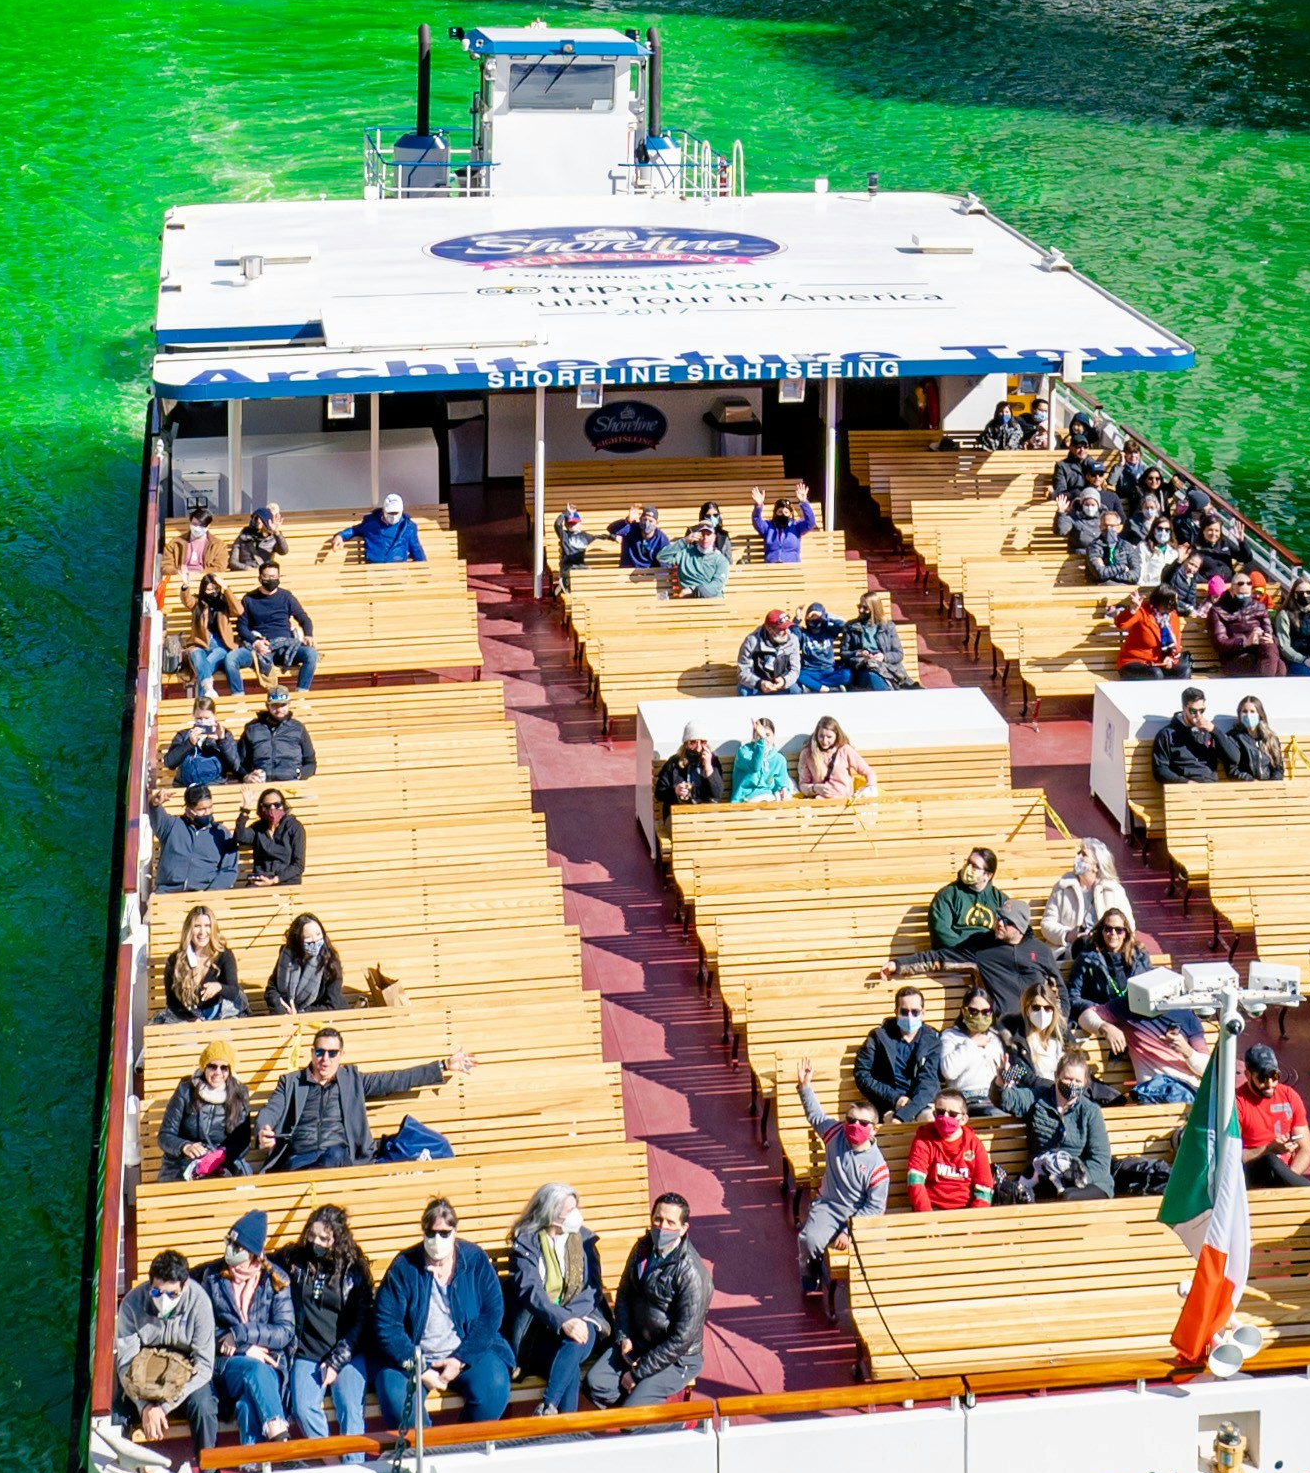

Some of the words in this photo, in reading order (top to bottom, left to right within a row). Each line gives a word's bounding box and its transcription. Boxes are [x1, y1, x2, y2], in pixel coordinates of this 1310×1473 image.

[465, 235, 740, 255] Shoreline
[532, 297, 614, 308] ular
[631, 296, 714, 307] Tour
[727, 293, 764, 304] in
[780, 292, 944, 303] America
[616, 307, 690, 317] 2017
[487, 365, 671, 388] SHORELINE
[687, 360, 900, 381] SIGHTSEEING
[593, 415, 659, 432] Shoreline
